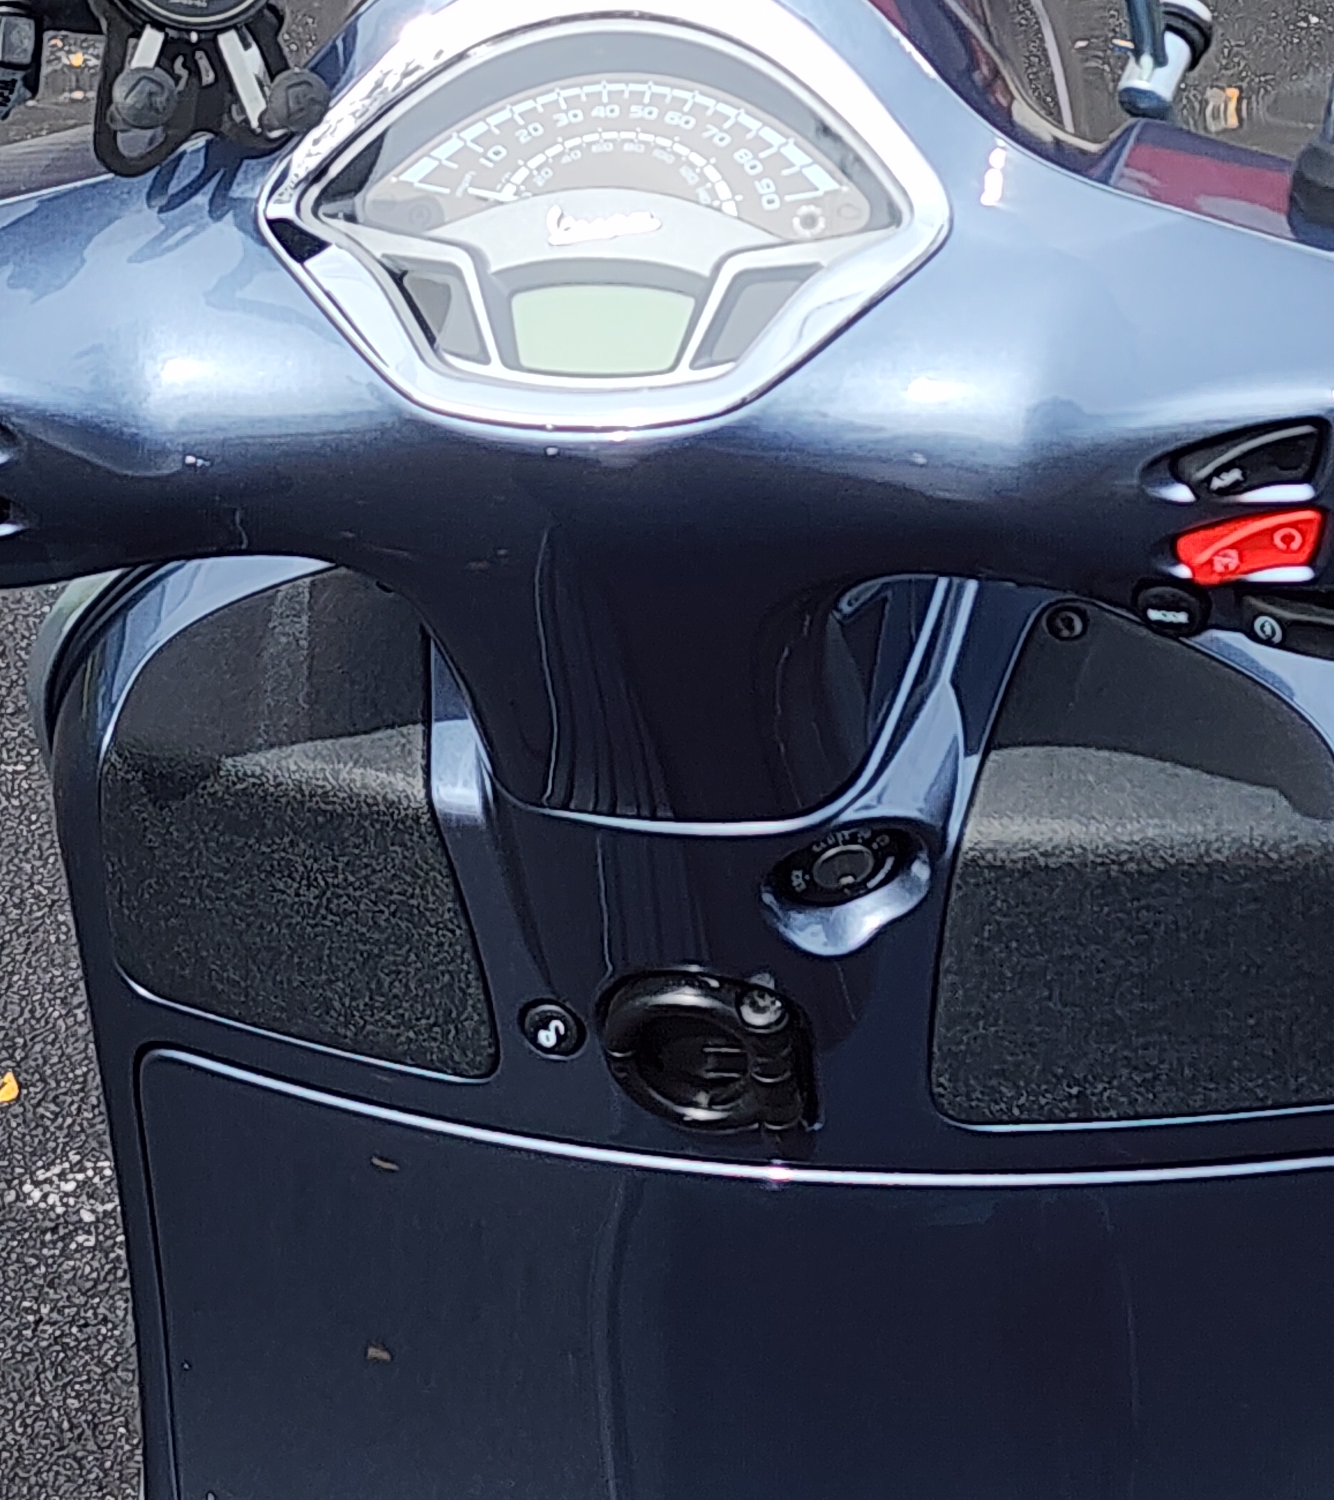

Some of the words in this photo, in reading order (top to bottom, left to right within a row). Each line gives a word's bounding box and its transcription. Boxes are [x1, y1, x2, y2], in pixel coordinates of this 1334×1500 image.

[479, 144, 508, 168] 10
[515, 122, 544, 144] 20
[552, 109, 584, 128] 30
[590, 104, 620, 118] 40
[629, 105, 659, 120] 50
[664, 110, 696, 130] 60
[701, 124, 732, 148] 70
[732, 148, 763, 175] 80
[754, 177, 781, 210] 90
